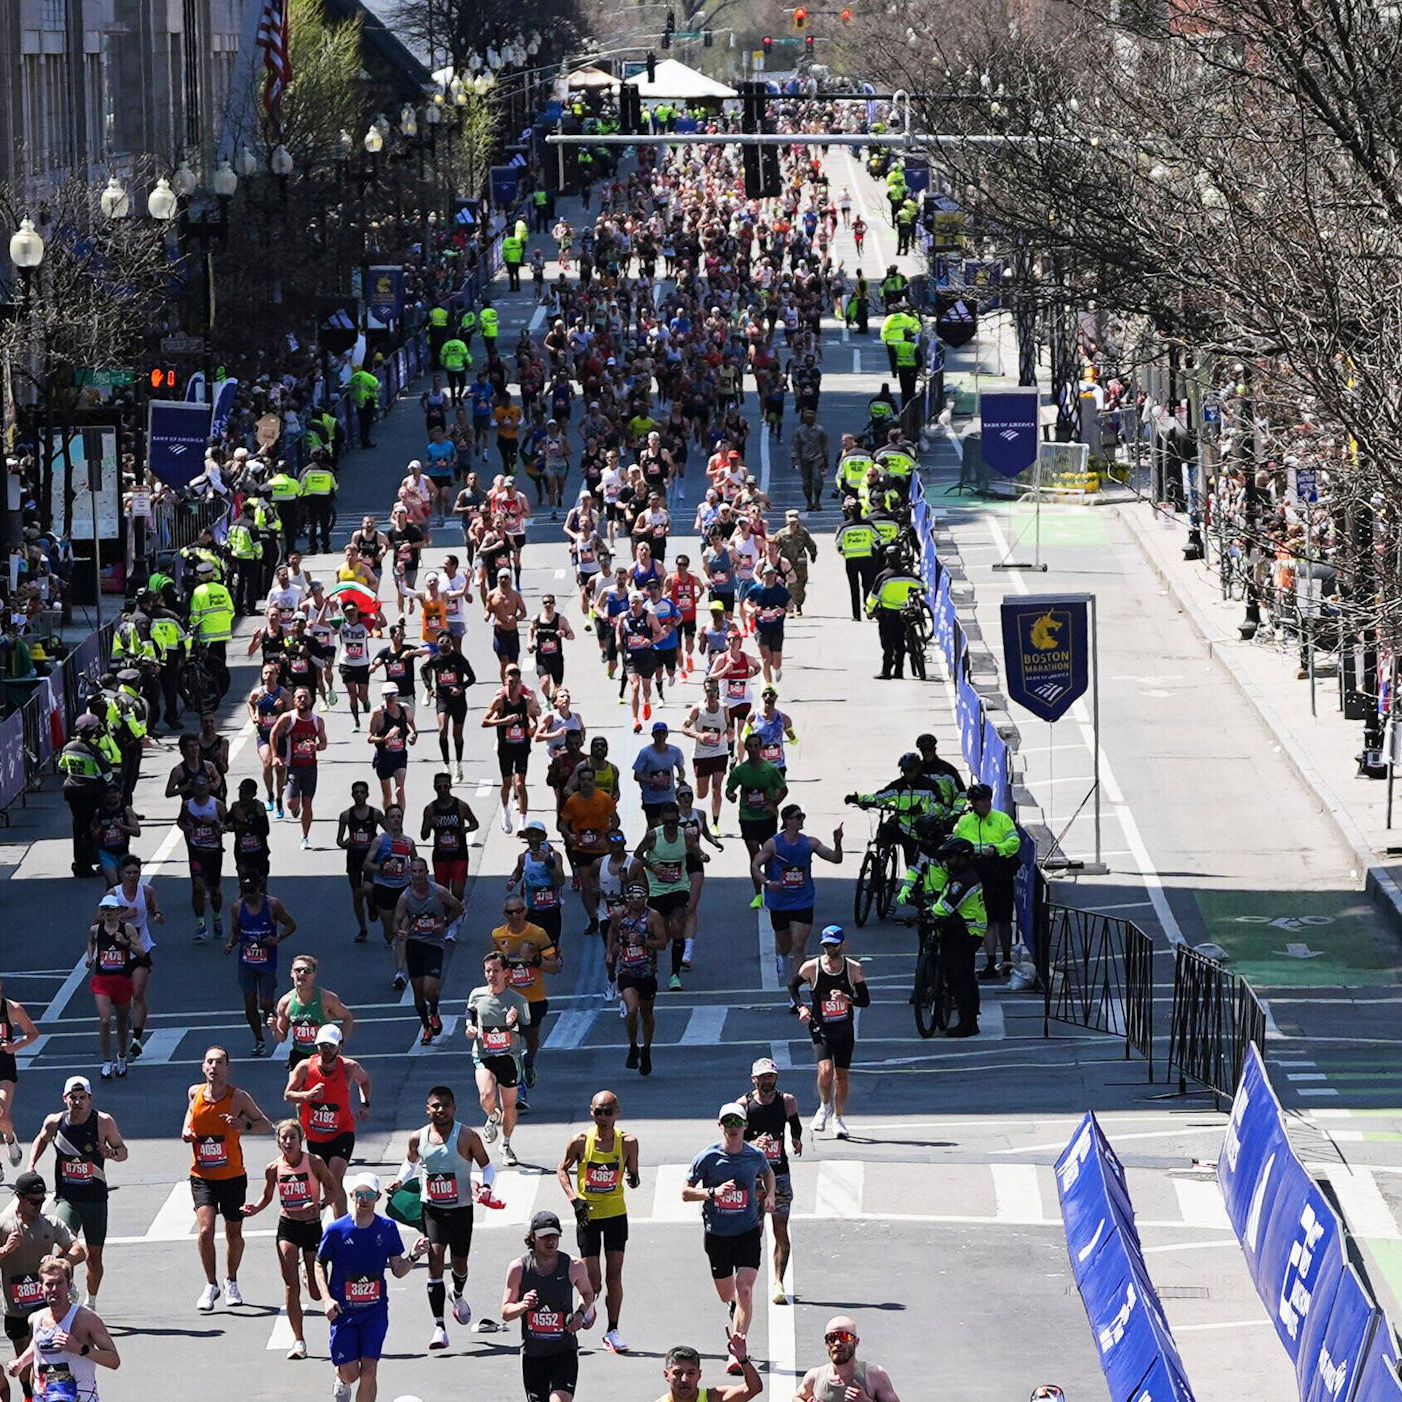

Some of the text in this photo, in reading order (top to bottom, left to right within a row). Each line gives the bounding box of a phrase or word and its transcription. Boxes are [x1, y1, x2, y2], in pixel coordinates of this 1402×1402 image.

[1024, 652, 1069, 665] BOSTON
[1025, 662, 1069, 672] MARATHON
[313, 1111, 335, 1123] 2192
[591, 1169, 614, 1182] 4362
[283, 1183, 306, 1195] 3748
[430, 1181, 453, 1194] 4108
[351, 1283, 375, 1295] 3822
[532, 1312, 559, 1326] 4552
